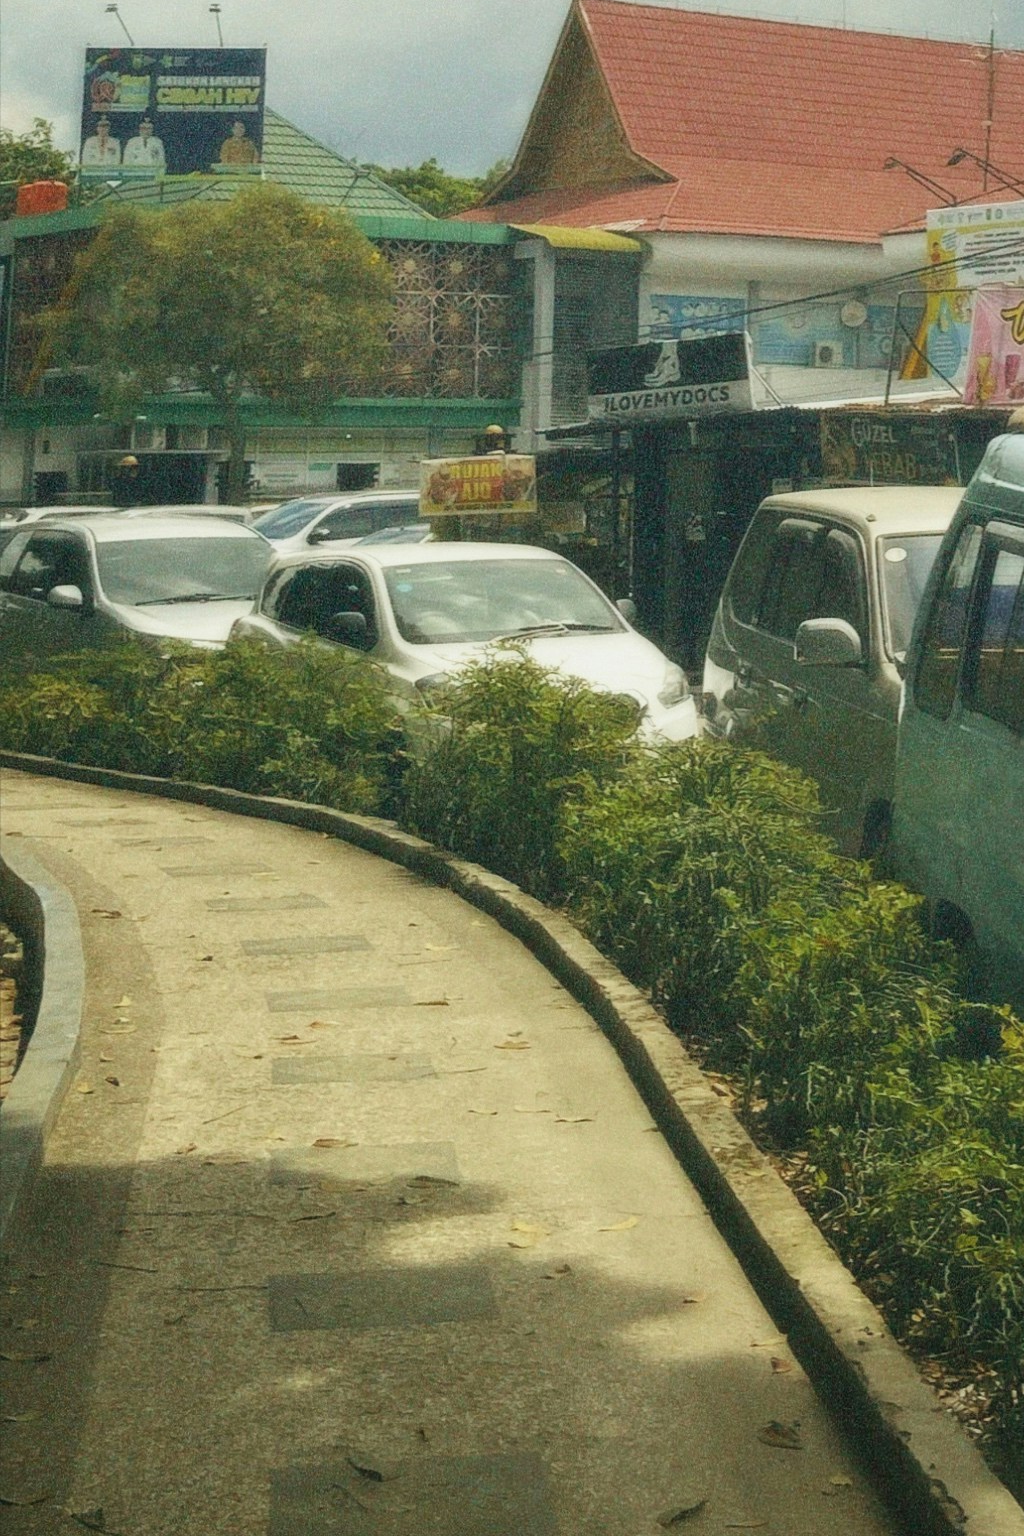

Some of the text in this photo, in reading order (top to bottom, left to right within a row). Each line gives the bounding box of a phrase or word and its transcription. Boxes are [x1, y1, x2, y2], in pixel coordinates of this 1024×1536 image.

[603, 385, 730, 412] ILOVEMYDOCS
[449, 463, 502, 479] RUJAK
[462, 481, 491, 500] AJO
